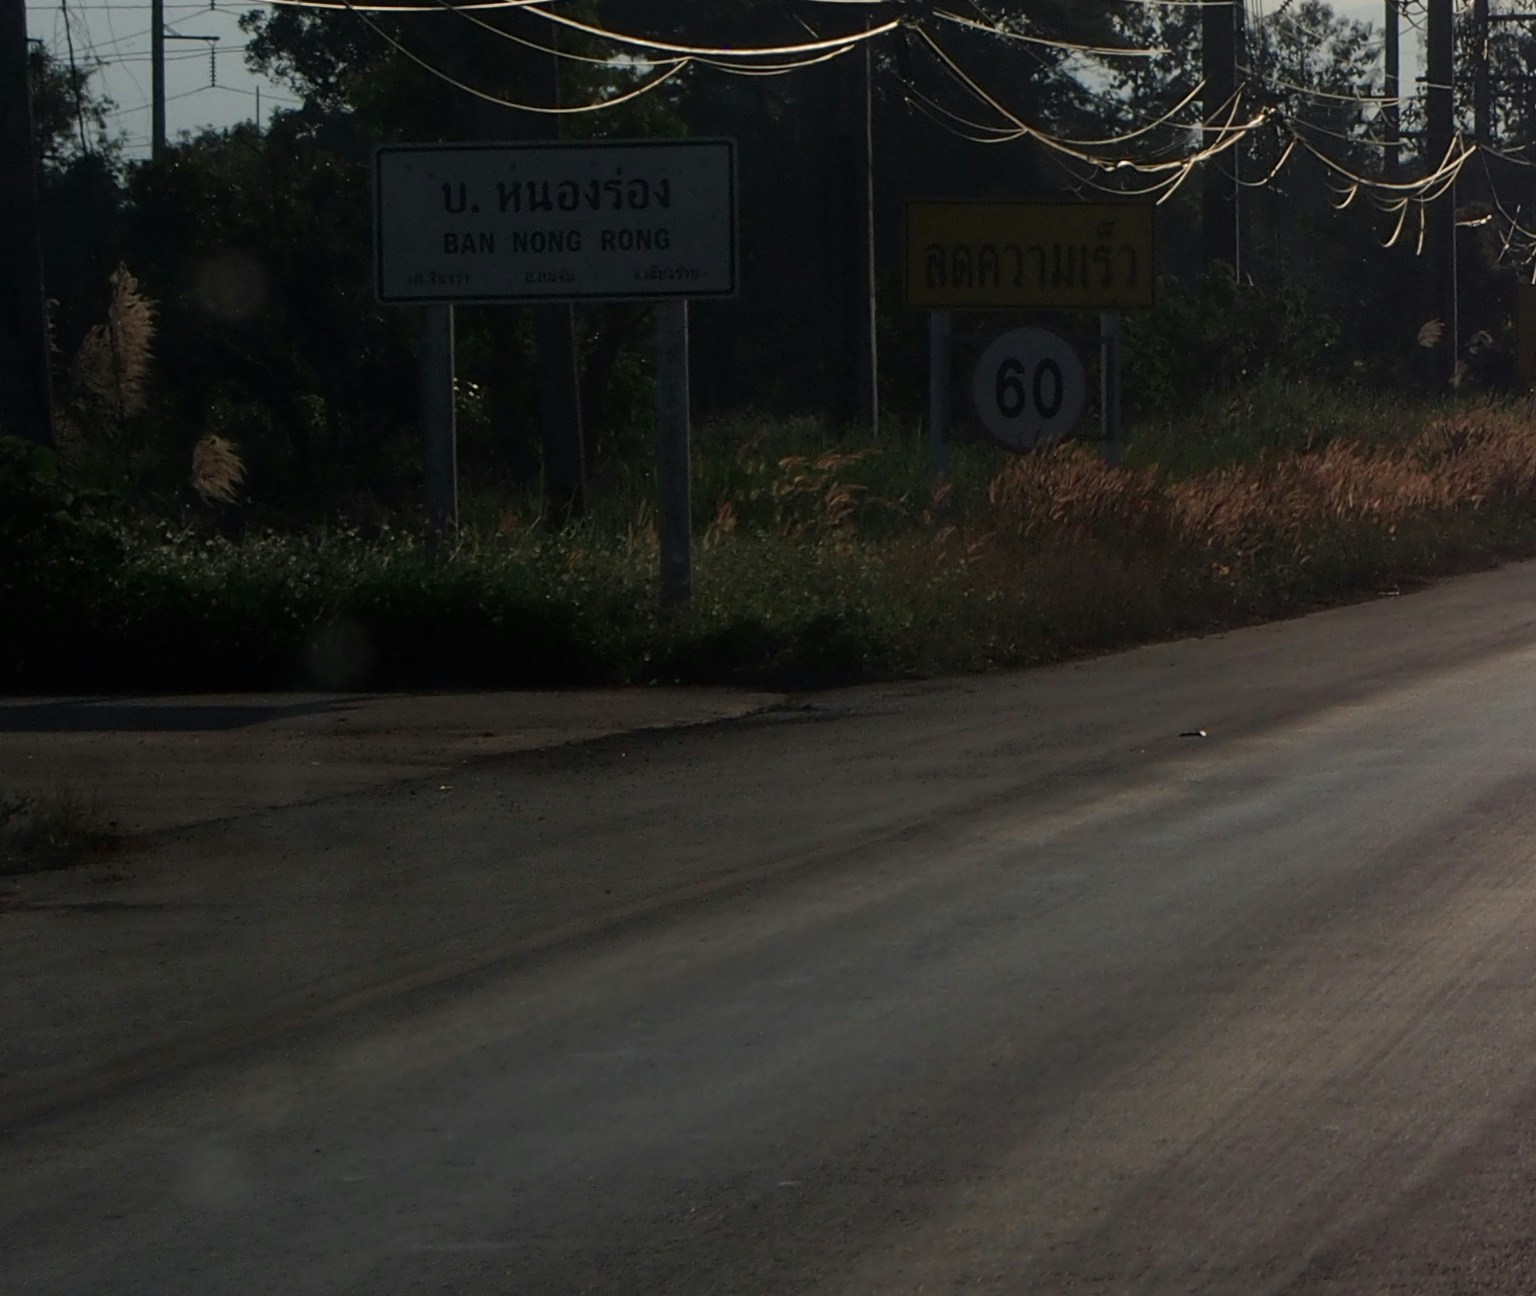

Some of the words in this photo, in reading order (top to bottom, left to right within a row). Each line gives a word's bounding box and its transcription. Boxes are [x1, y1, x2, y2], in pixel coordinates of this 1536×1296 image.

[442, 183, 480, 213] บ.
[496, 166, 671, 212] หนองร่อง
[444, 233, 494, 254] BAN
[513, 230, 581, 252] NONG
[601, 229, 670, 251] RONG
[924, 219, 1137, 288] ลดความเร็ว
[996, 358, 1063, 418] 60
